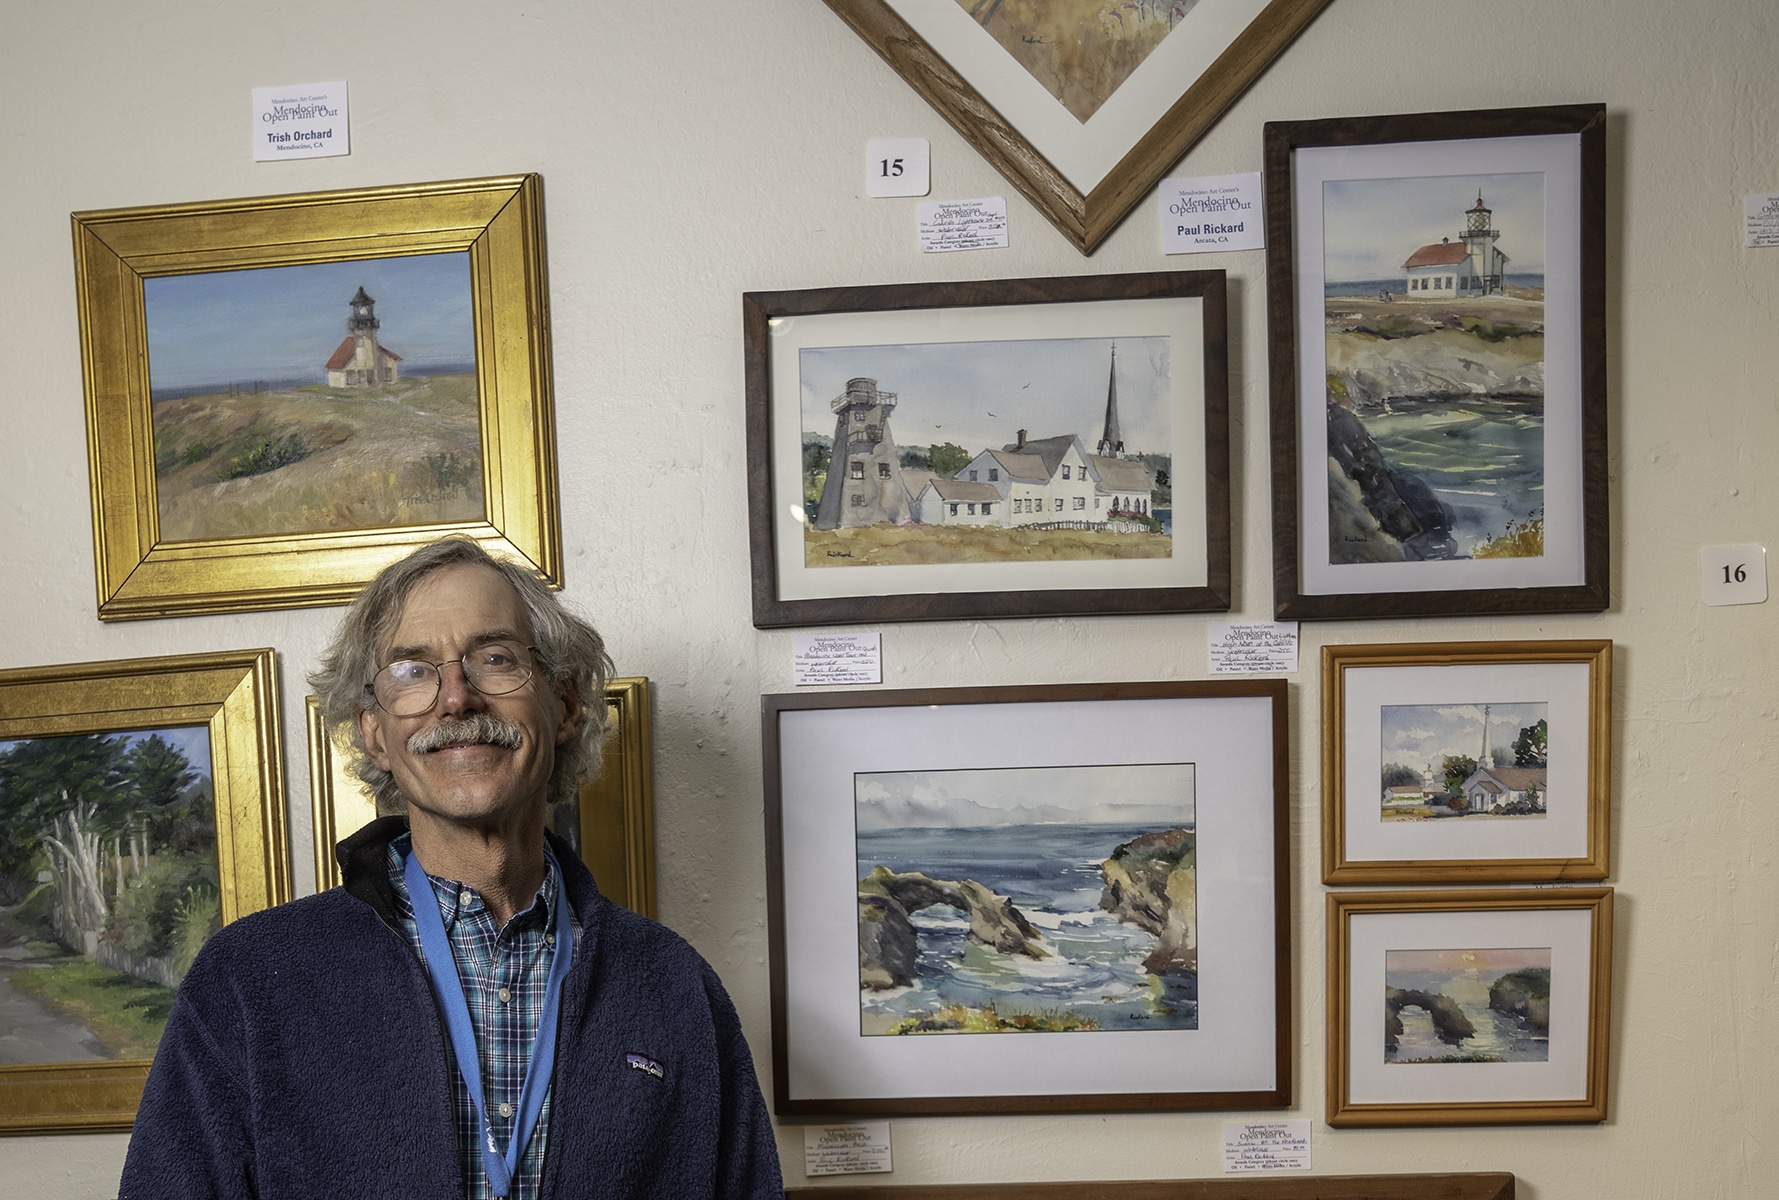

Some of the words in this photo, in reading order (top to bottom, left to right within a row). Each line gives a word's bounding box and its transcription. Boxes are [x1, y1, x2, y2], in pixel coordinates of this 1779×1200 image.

[263, 112, 288, 124] Open
[292, 110, 315, 120] Paint
[319, 109, 337, 117] Out
[274, 104, 327, 115] Mendocino
[267, 132, 290, 143] Trish
[294, 128, 332, 141] Orchard
[881, 159, 904, 177] 15
[1170, 204, 1197, 216] Open
[1202, 202, 1226, 212] Paint
[1231, 201, 1251, 210] Out
[1181, 196, 1239, 208] Mendocino
[1177, 225, 1200, 235] Paul
[1204, 222, 1244, 234] Rickard
[1722, 563, 1746, 584] 16
